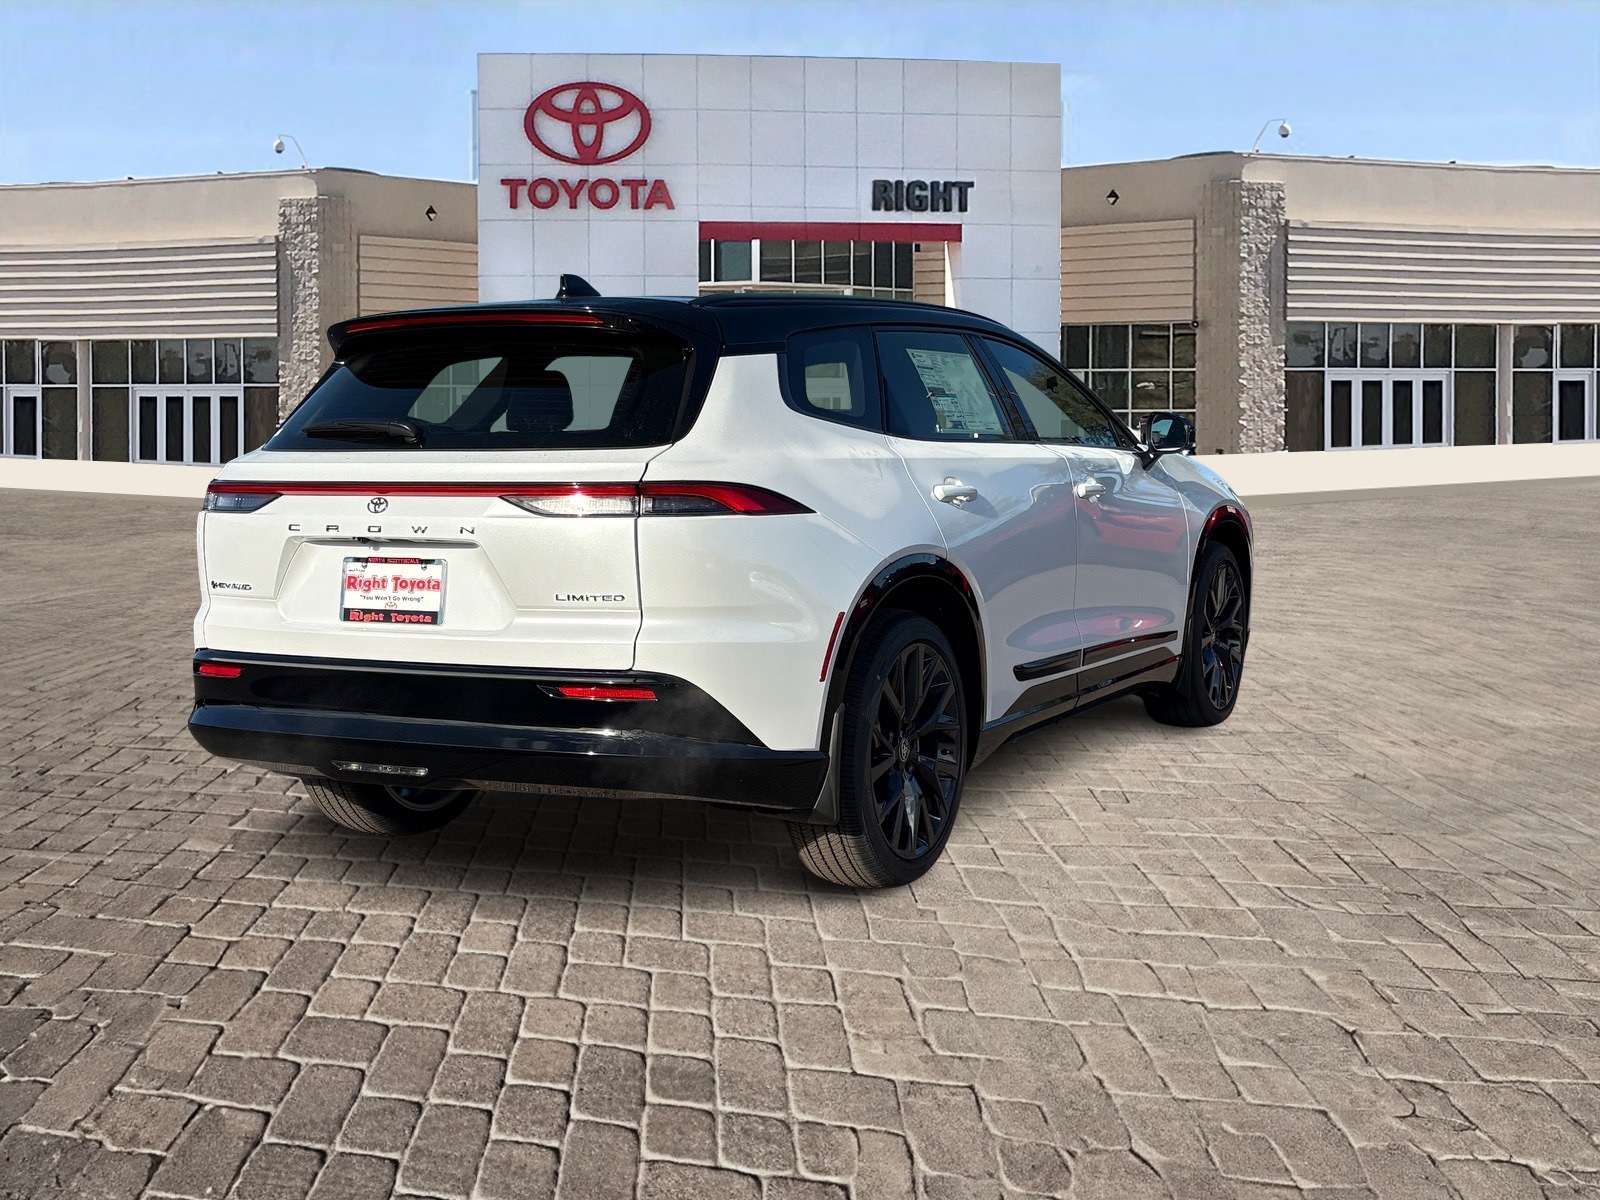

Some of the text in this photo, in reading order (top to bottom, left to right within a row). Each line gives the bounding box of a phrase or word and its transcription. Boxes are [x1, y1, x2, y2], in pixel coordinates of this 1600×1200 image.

[500, 177, 676, 210] TOYOTA
[871, 179, 975, 213] RIGHT
[288, 523, 476, 535] CROWN
[346, 574, 441, 593] Right Toyota
[555, 593, 626, 602] LIMITED
[349, 610, 432, 623] Right Toyota
